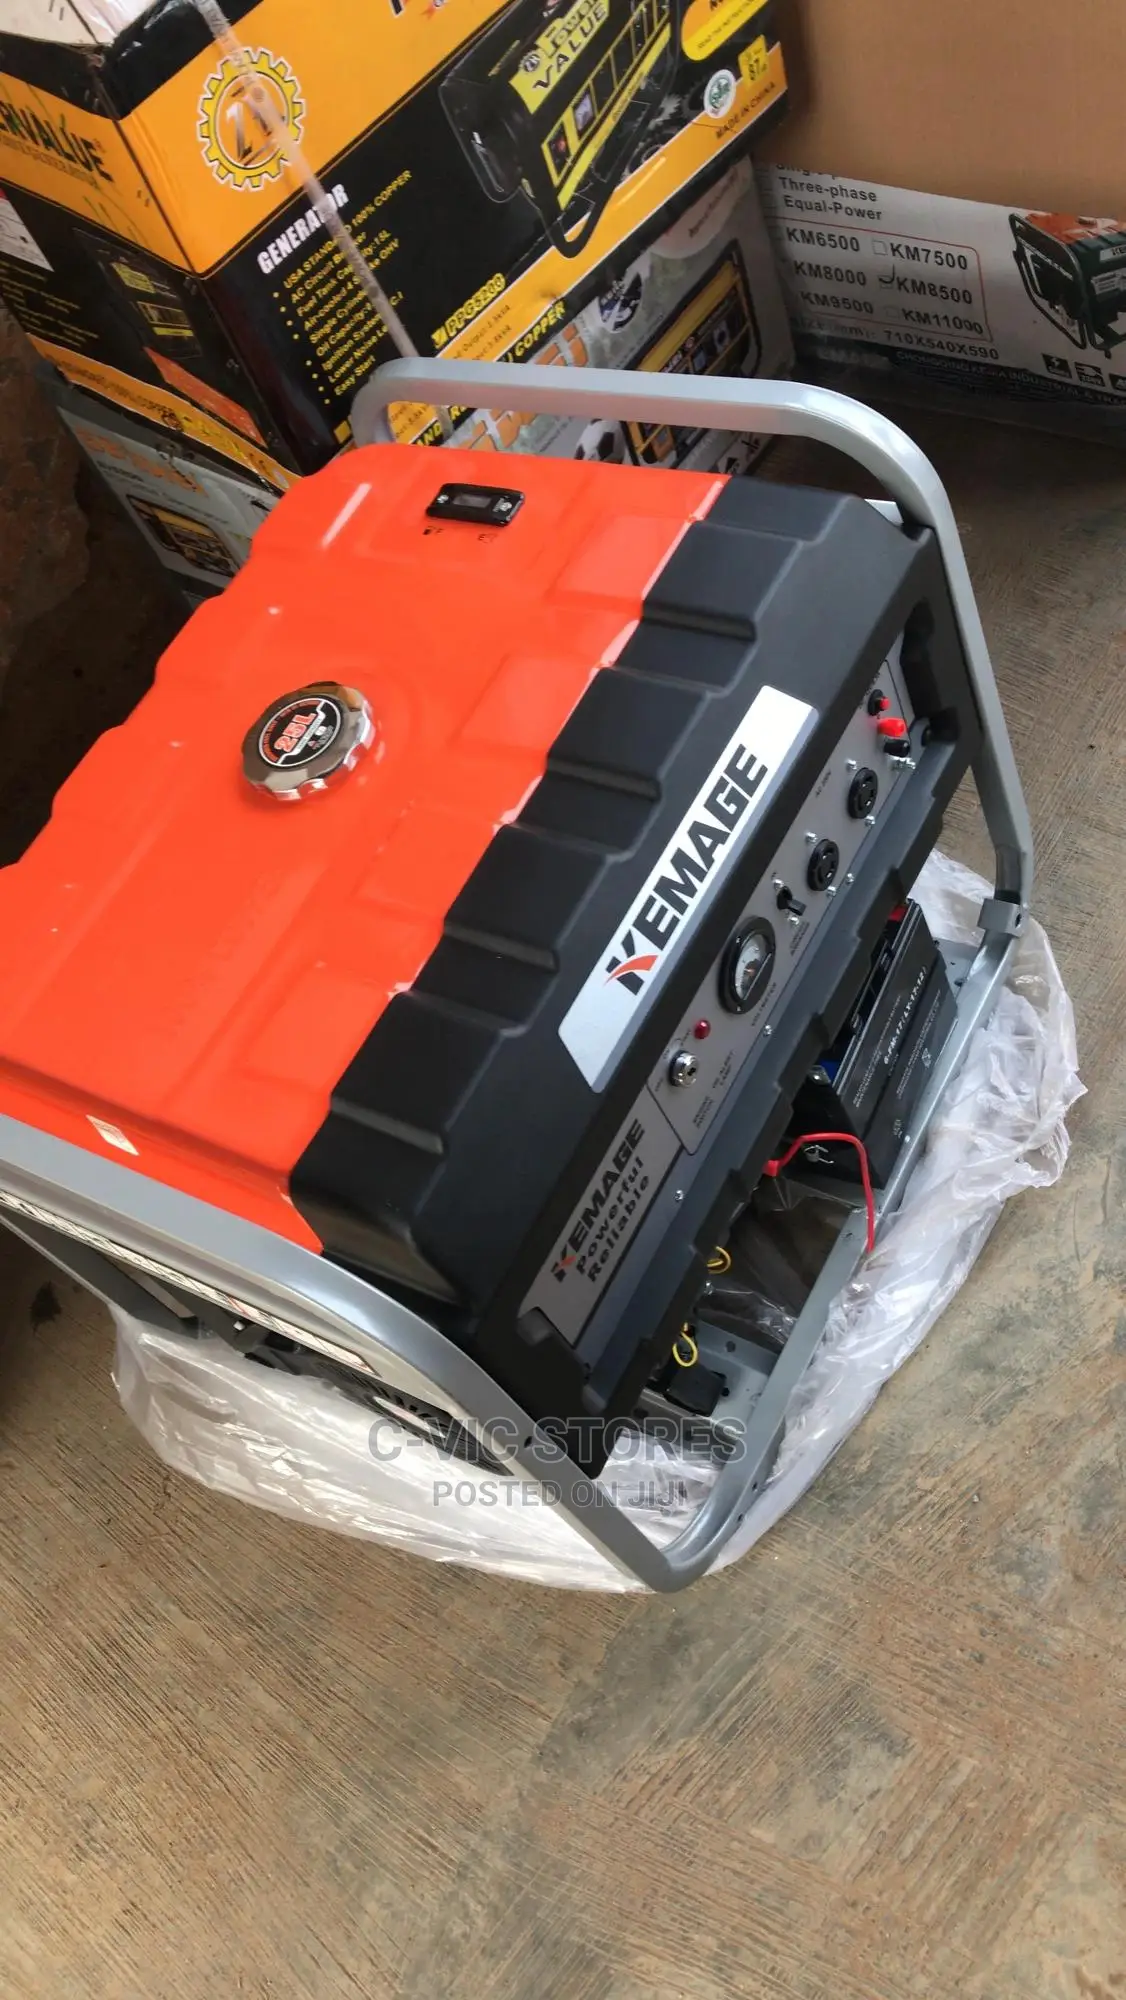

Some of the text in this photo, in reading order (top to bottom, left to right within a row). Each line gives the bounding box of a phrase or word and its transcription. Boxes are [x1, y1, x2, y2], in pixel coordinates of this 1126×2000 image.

[532, 6, 606, 89] VALUE
[778, 176, 877, 202] Three-phase
[783, 194, 882, 220] Equal-Power
[283, 170, 412, 289] USA STANDD 100% COPPER
[379, 238, 400, 260] OHV
[786, 227, 968, 271] KM6500 KM7500
[291, 231, 367, 304] AC Circuit Brker
[794, 260, 973, 304] KM8000 KM8500
[296, 295, 317, 317] Fuel
[315, 278, 338, 299] Tank
[309, 287, 370, 344] Single Cylinde
[444, 273, 506, 338] PPG5200
[800, 290, 984, 335] KM9500 KM11000
[515, 301, 566, 357] COPPER
[884, 329, 999, 360] 710X540X590
[321, 340, 354, 371] Ignition
[328, 335, 378, 383] Lower Noise
[334, 355, 376, 396] Easy Start
[274, 713, 317, 752] 25L
[603, 744, 768, 996] KEMAGE
[551, 1118, 645, 1283] KEMAGE
[576, 1156, 644, 1275] Powerful
[587, 1175, 650, 1283] Reliable
